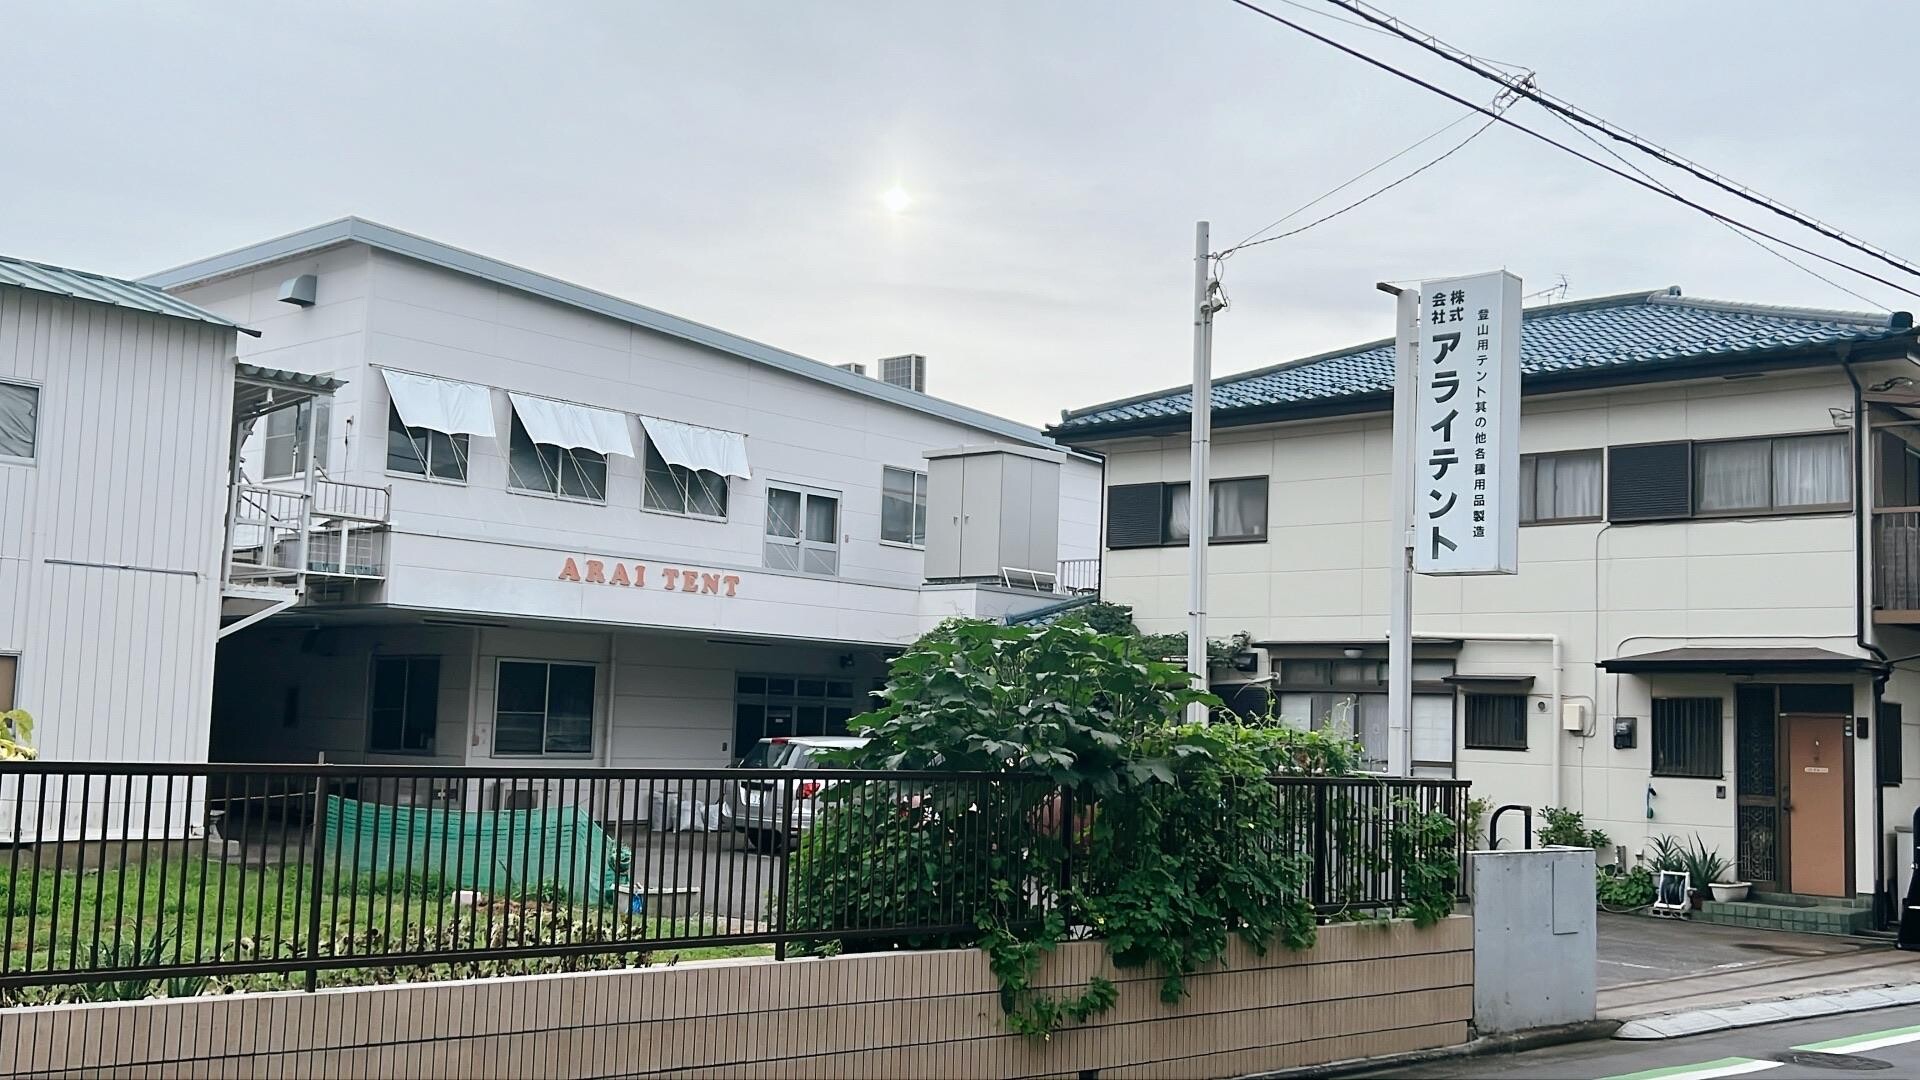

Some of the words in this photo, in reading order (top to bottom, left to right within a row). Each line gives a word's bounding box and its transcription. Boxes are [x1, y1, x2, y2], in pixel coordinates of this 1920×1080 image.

[1431, 292, 1447, 324] 会社
[1449, 289, 1465, 322] 株式
[1473, 308, 1489, 538] 登山用テント其の他各種用品製造
[1429, 331, 1461, 560] アライテント
[558, 557, 646, 588] ARAI
[661, 568, 740, 597] TENT
